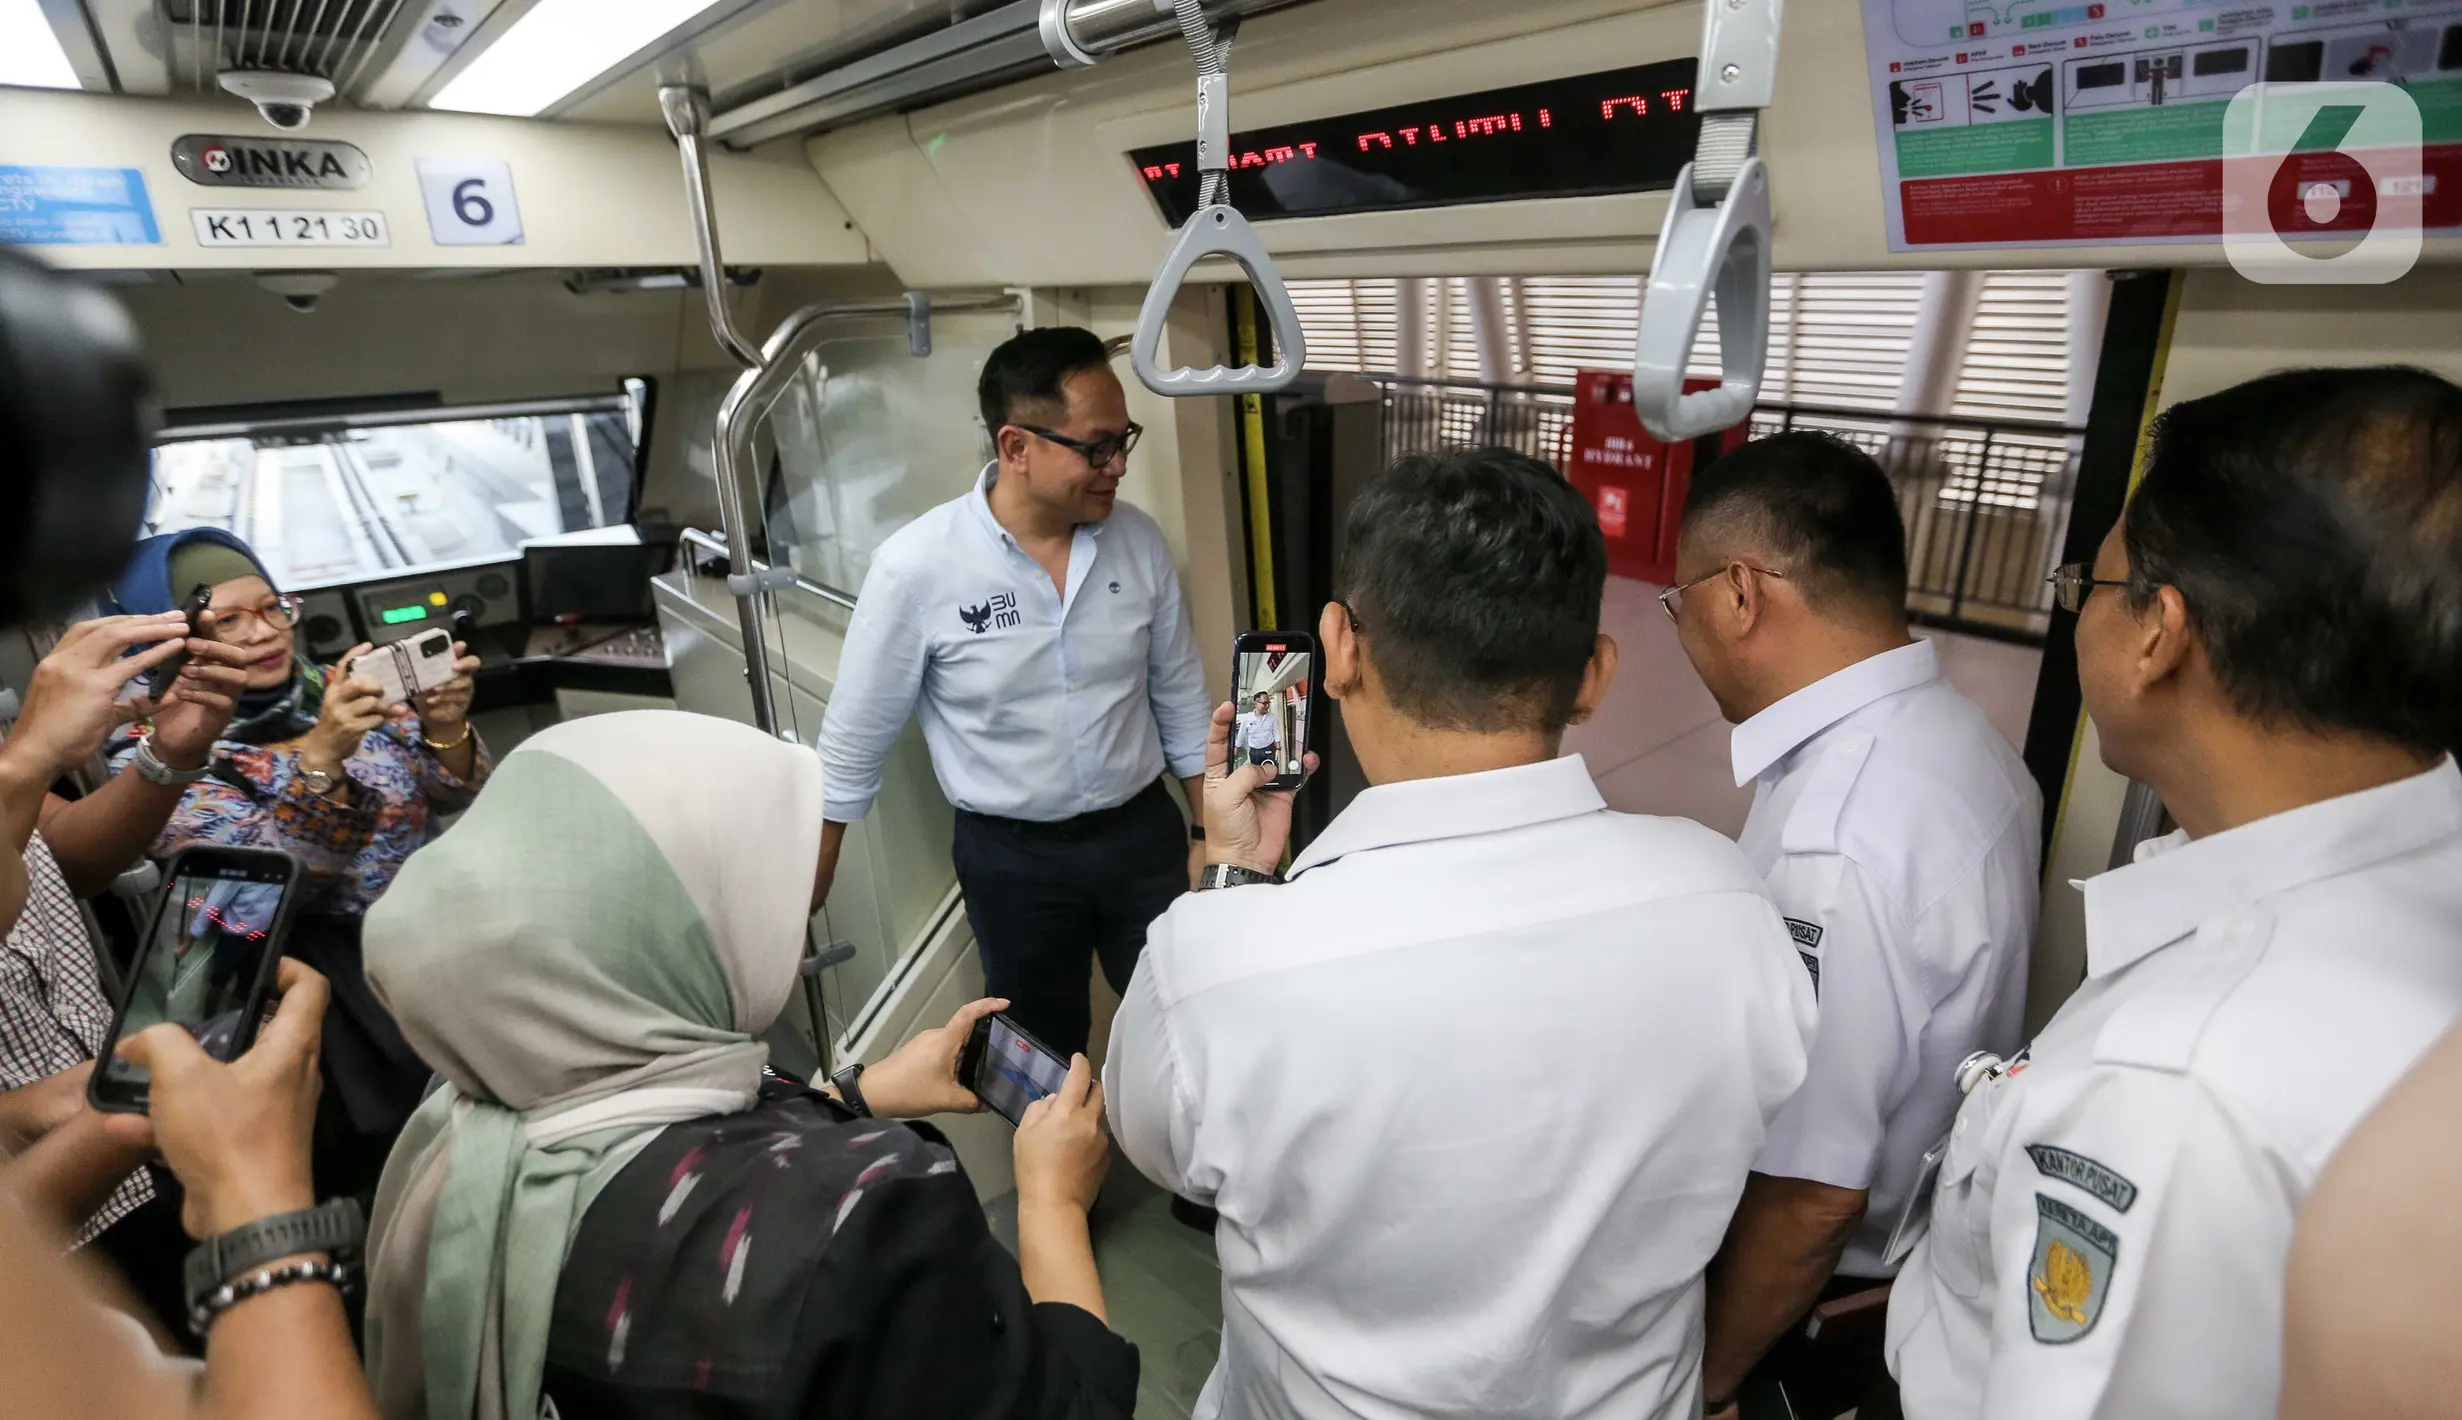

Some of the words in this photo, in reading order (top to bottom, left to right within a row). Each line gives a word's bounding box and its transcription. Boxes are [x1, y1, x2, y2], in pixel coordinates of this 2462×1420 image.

[232, 148, 348, 178] INKA
[453, 178, 494, 226] 6
[1790, 922, 1817, 942] PUSAT
[2037, 1149, 2085, 1180] KANTOR
[2085, 1166, 2129, 1206] PUSAT
